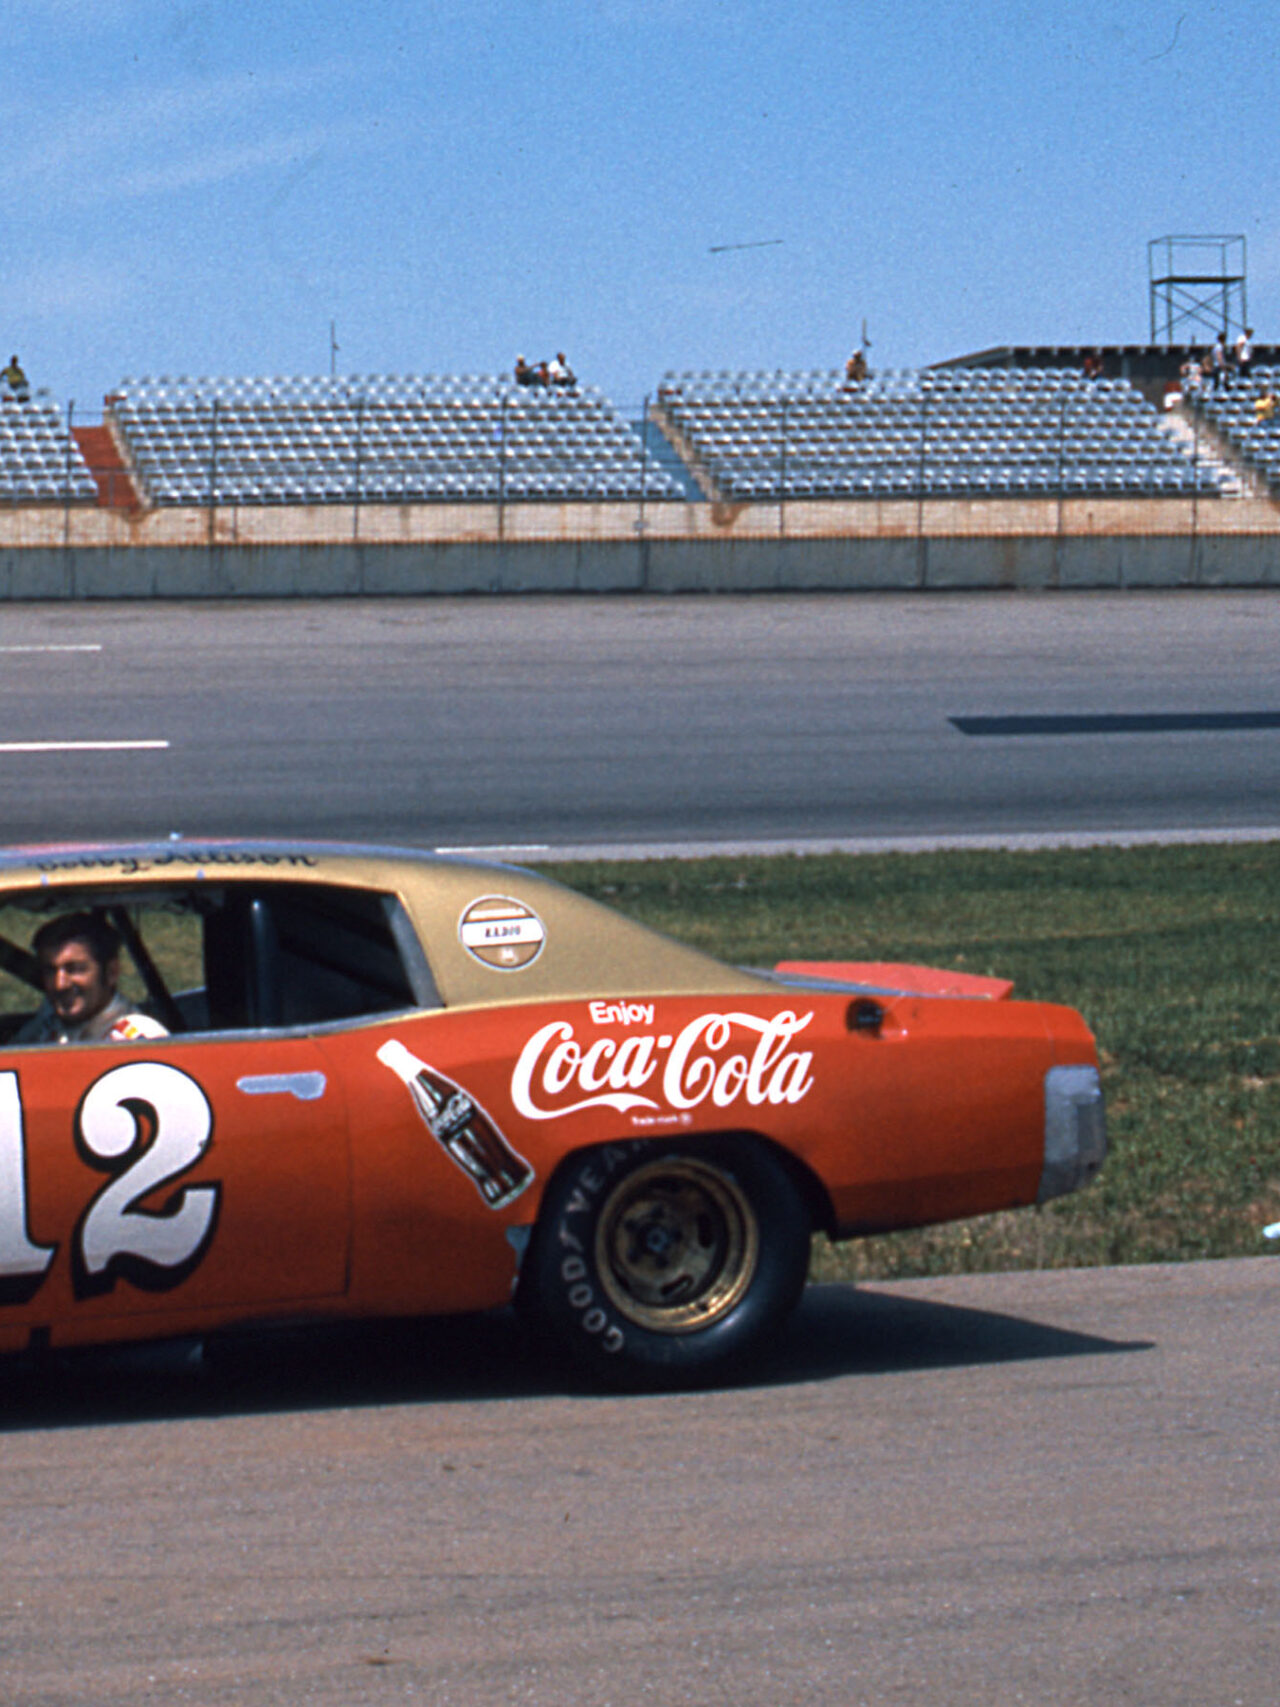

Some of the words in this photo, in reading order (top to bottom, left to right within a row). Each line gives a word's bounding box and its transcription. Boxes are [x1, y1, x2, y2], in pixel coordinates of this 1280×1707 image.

[511, 1011, 814, 1119] Coca-Cola
[589, 1001, 654, 1025] Enjoy
[559, 1140, 650, 1353] GOODYEA
